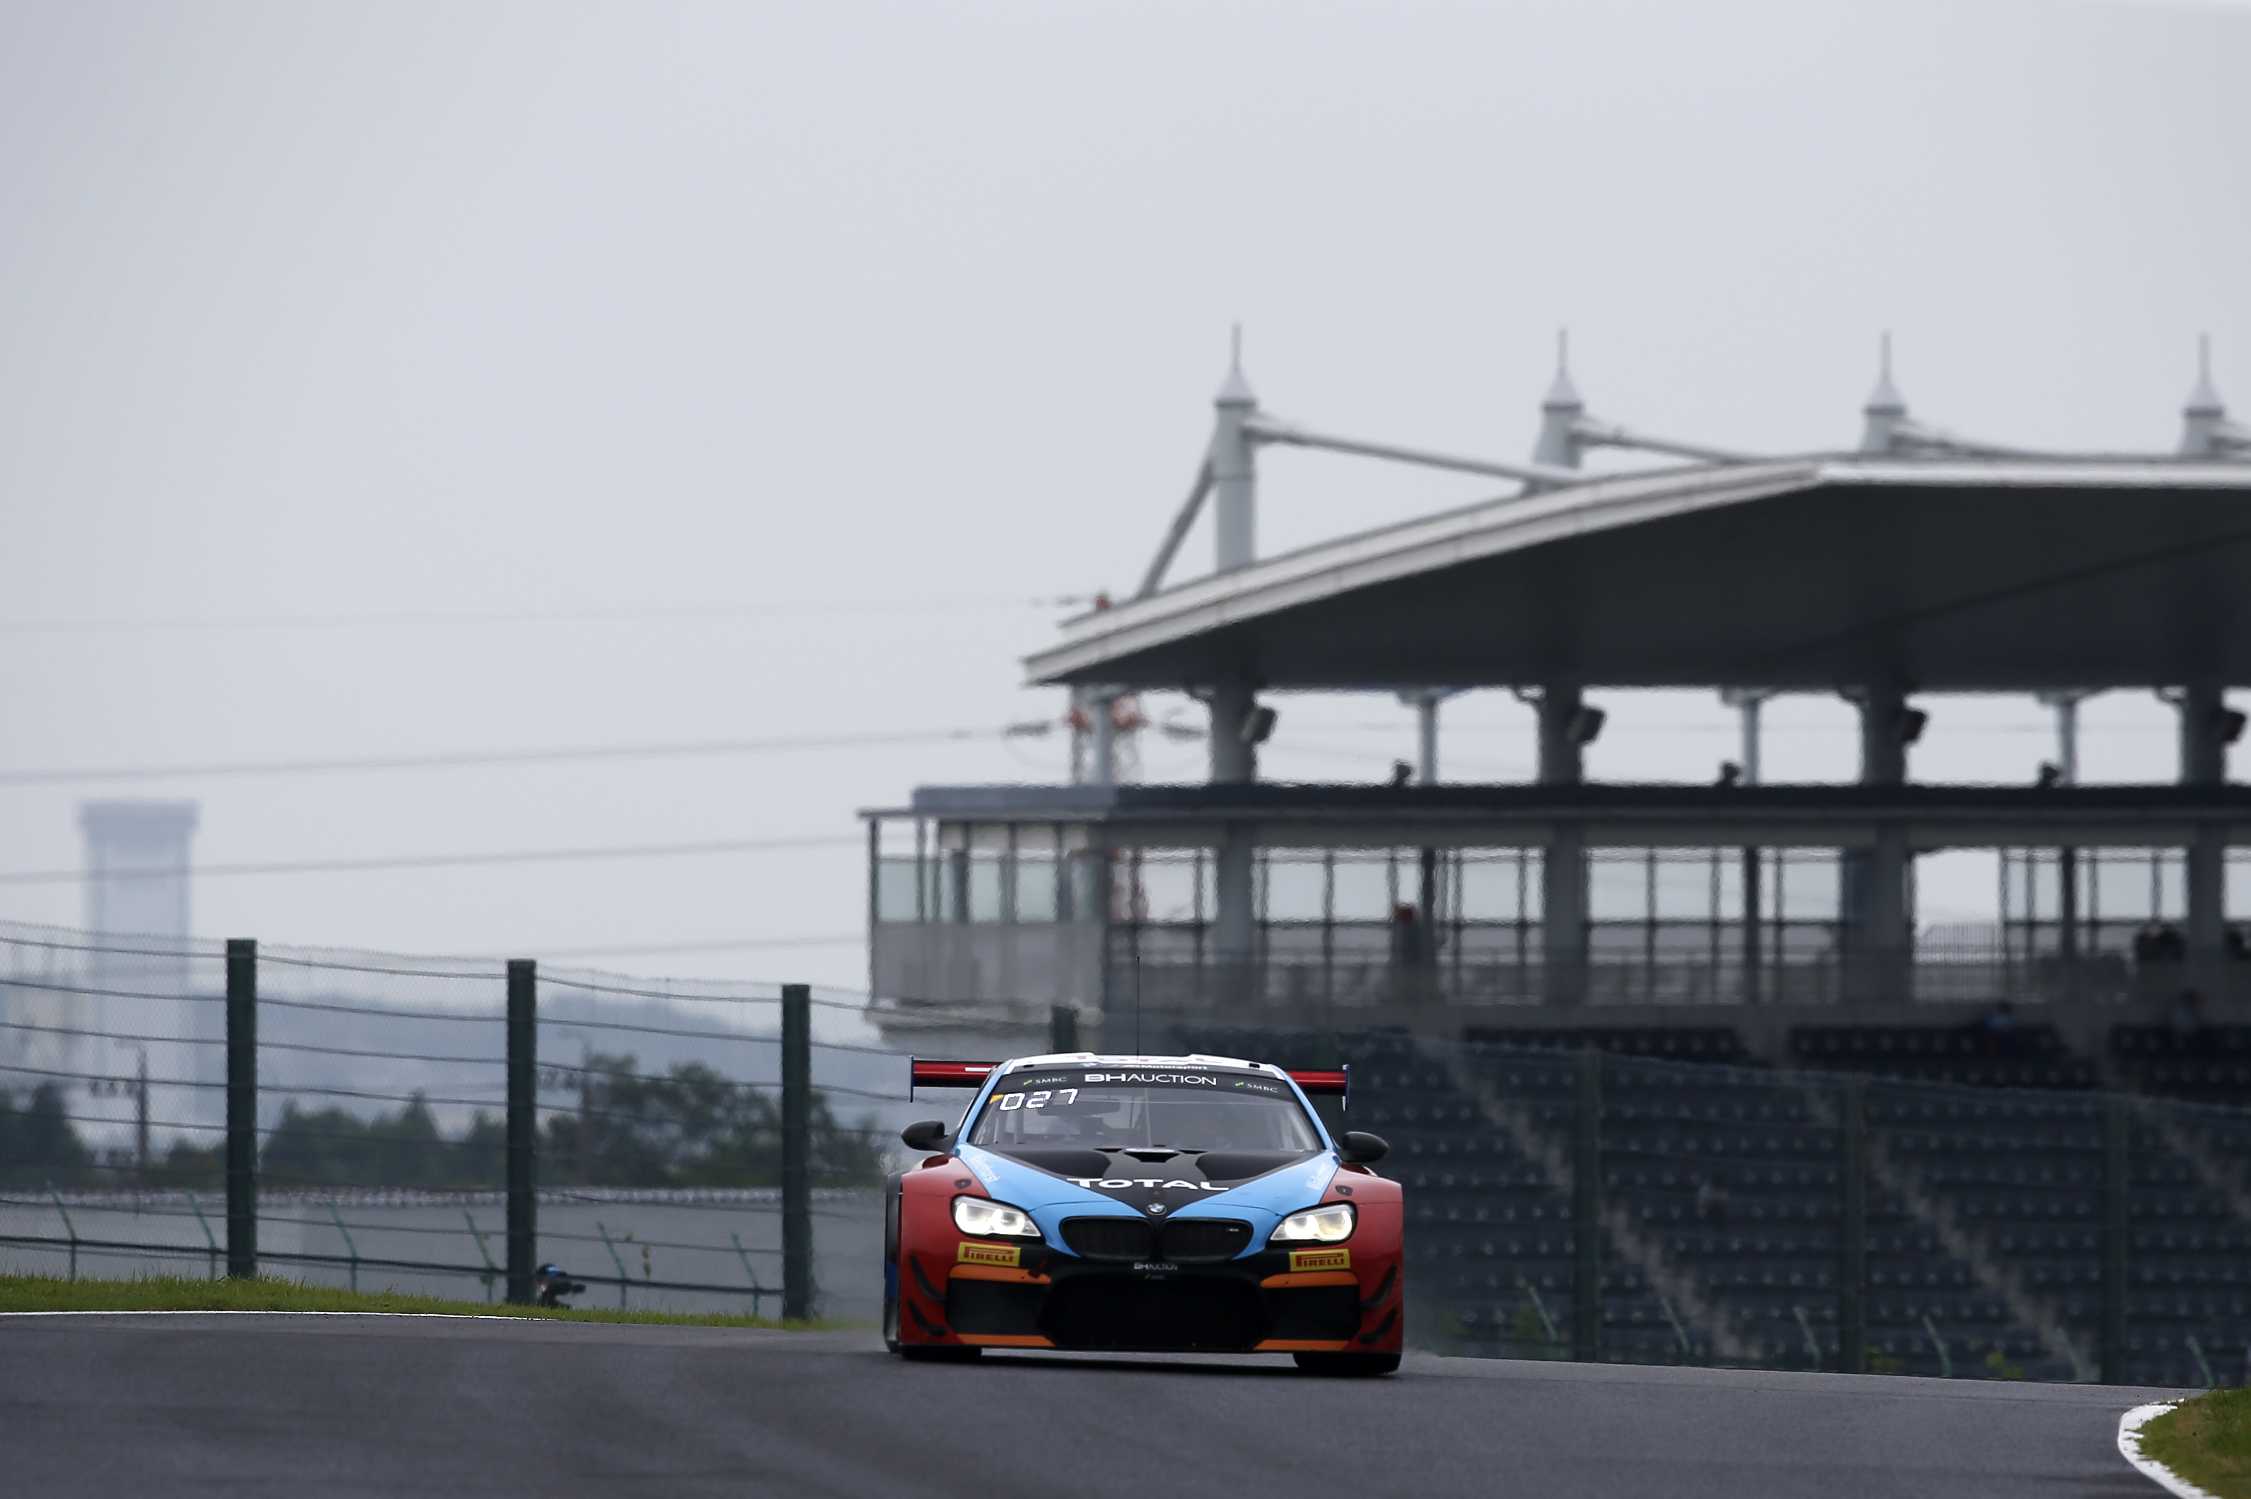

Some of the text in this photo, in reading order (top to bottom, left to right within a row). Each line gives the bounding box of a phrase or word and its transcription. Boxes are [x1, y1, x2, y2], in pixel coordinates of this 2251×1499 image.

[1035, 1076, 1067, 1084] SMBC
[1247, 1083, 1279, 1094] SMBC
[1000, 1088, 1078, 1111] 027
[1066, 1178, 1229, 1190] TOTAL
[963, 1246, 1015, 1262] PIRELLI
[1295, 1252, 1345, 1268] PIRELLI
